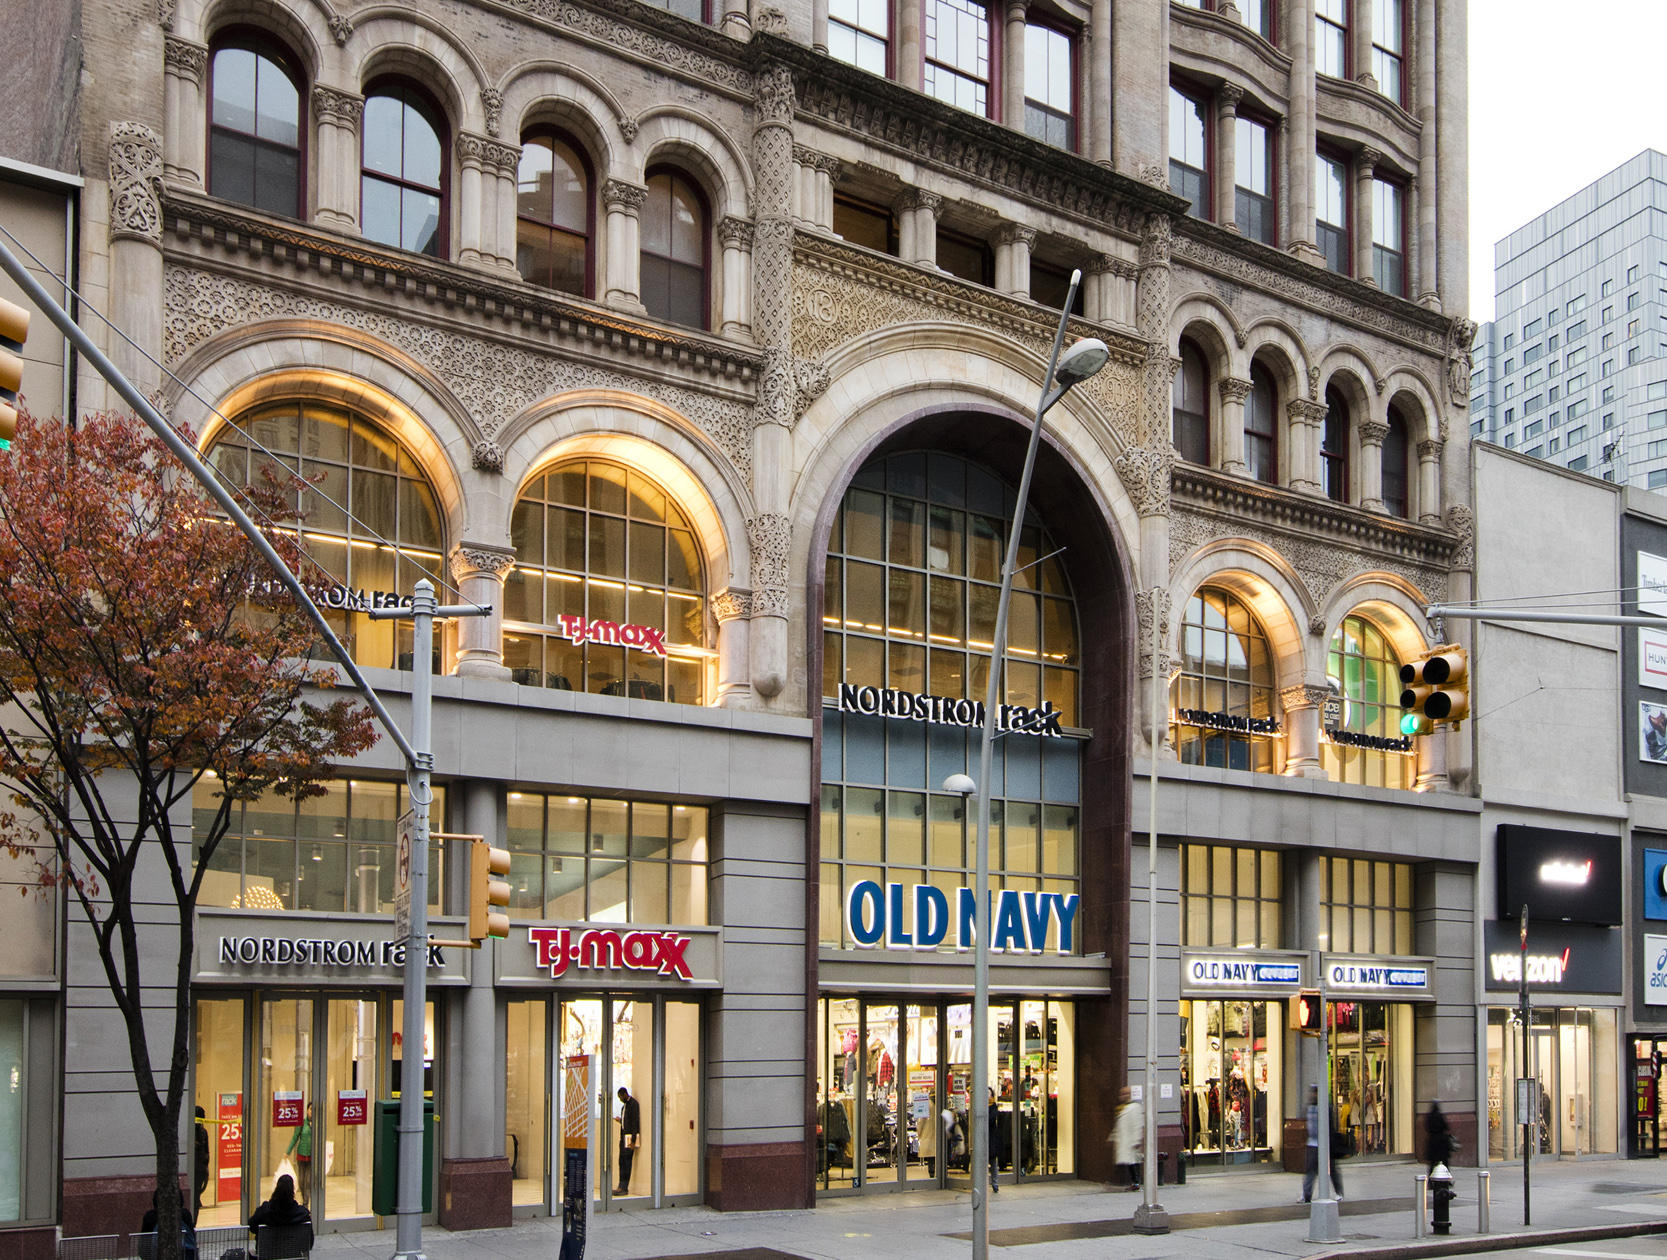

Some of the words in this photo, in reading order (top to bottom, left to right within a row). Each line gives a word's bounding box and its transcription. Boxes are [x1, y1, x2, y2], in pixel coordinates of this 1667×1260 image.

[369, 590, 415, 610] rac
[1648, 653, 1667, 665] HUN
[998, 701, 1063, 739] rack
[846, 880, 949, 952] OLD
[956, 887, 1080, 957] NAVY
[219, 936, 376, 967] NORDSTROM
[380, 933, 446, 968] rak
[1193, 961, 1220, 980] OLD
[1223, 963, 1258, 981] NAVY
[1333, 966, 1356, 983] OLD
[1360, 967, 1389, 985] NAVY
[1490, 954, 1562, 983] verzon
